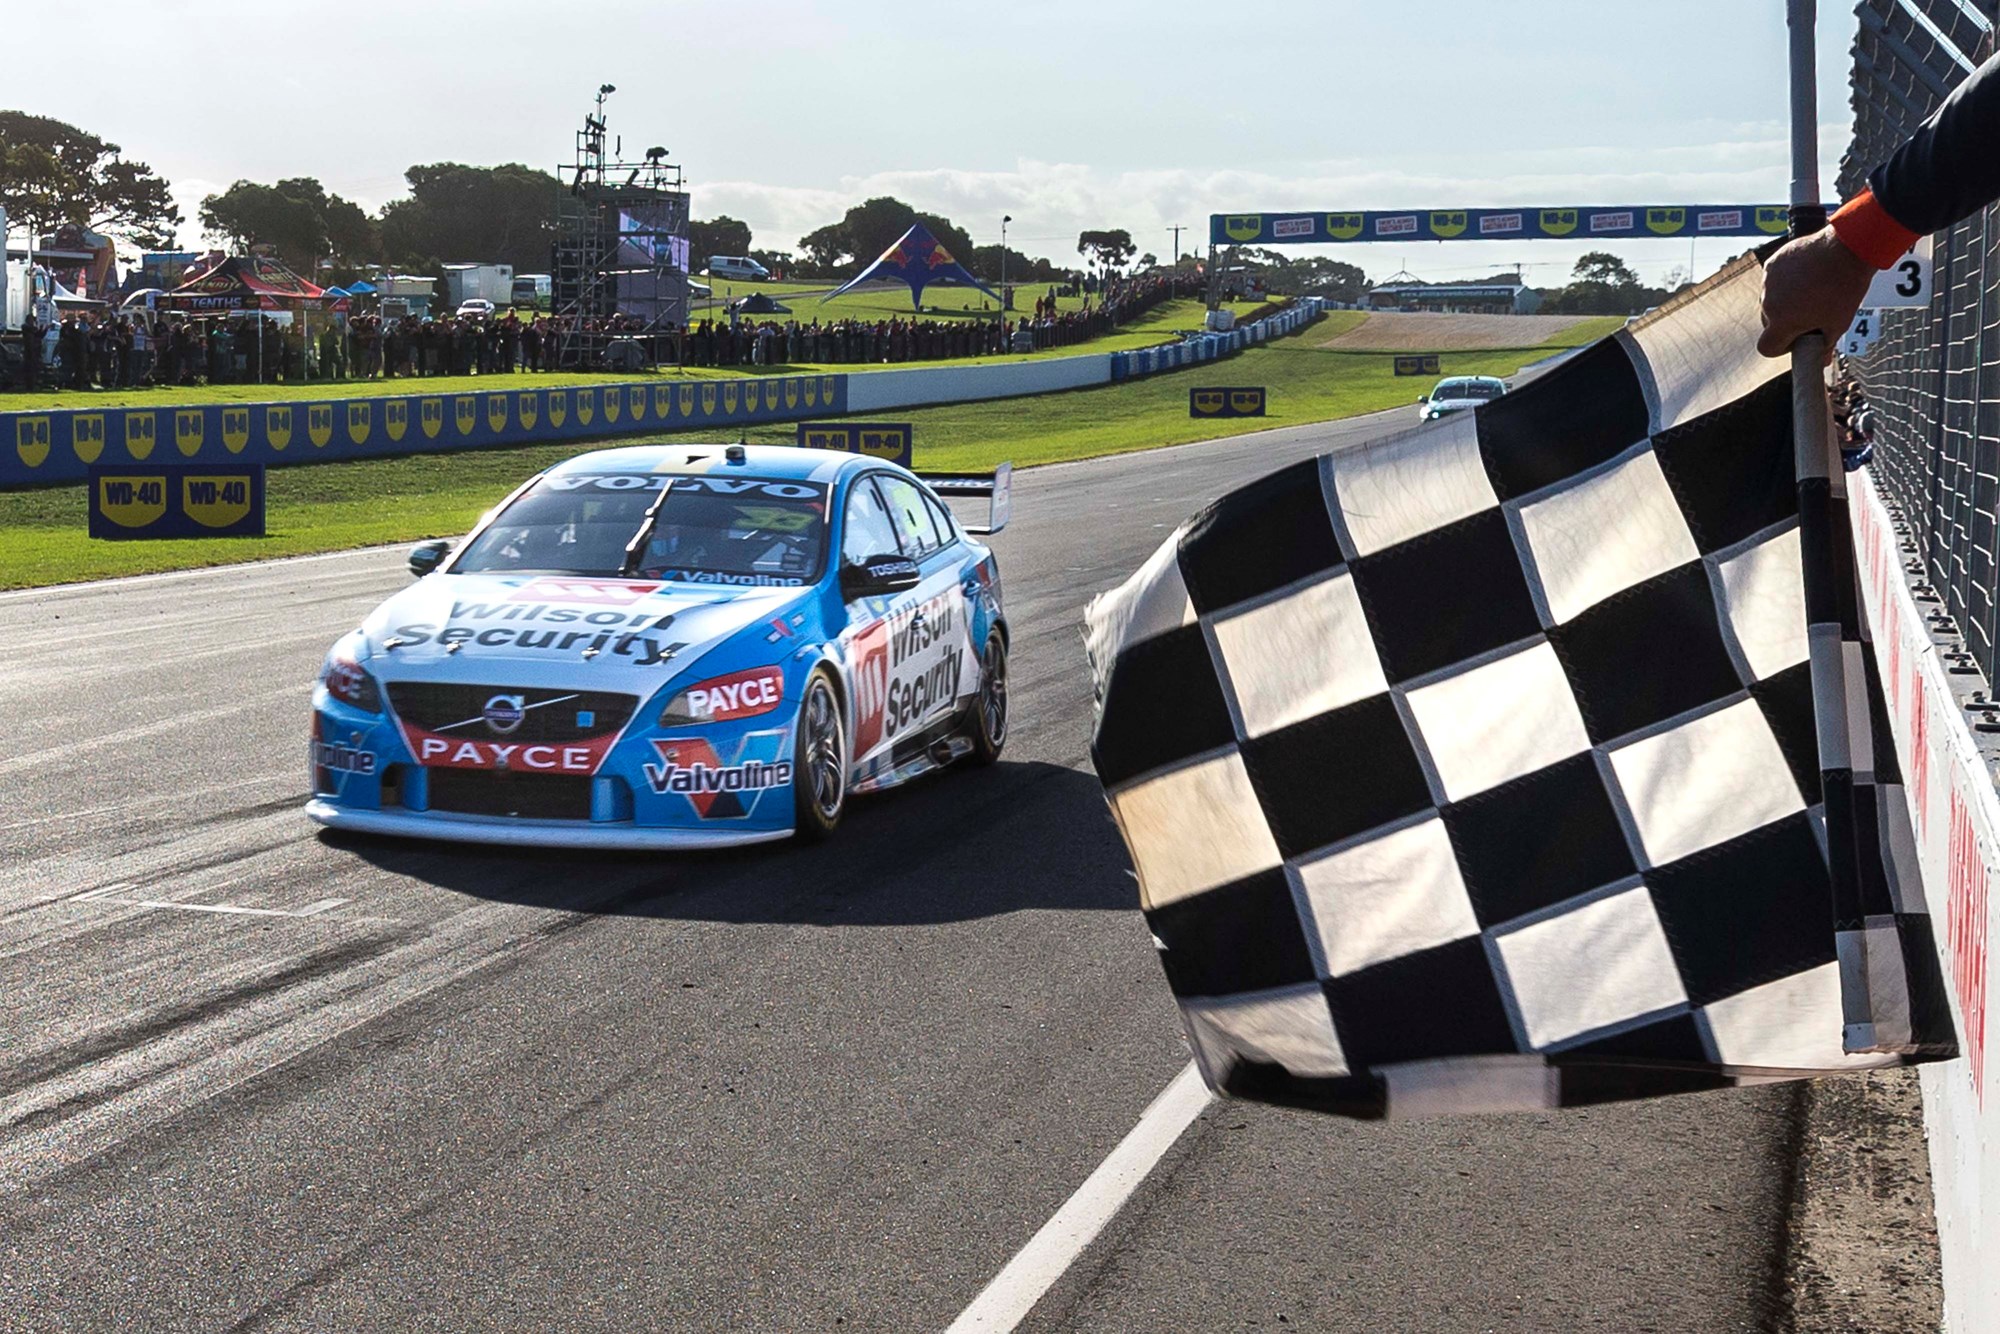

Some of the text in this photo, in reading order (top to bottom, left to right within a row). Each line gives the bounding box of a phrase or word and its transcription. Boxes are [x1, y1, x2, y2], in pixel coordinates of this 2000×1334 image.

[1896, 260, 1921, 297] 3
[1854, 319, 1869, 337] 4
[1850, 341, 1858, 353] 5
[21, 422, 48, 446] WD-40
[76, 419, 102, 442] WD-40
[809, 434, 845, 448] WD-40
[863, 434, 899, 449] WD-40
[105, 481, 162, 505] WD-40
[188, 481, 246, 505] WD-40
[546, 475, 820, 498] VOLVO
[682, 571, 803, 587] Valvoline
[450, 601, 676, 630] Wilson
[394, 623, 690, 665] Security
[687, 676, 779, 717] PAYCE
[885, 644, 963, 738] Security
[422, 738, 592, 770] PAYCE
[642, 758, 795, 794] Valvoline
